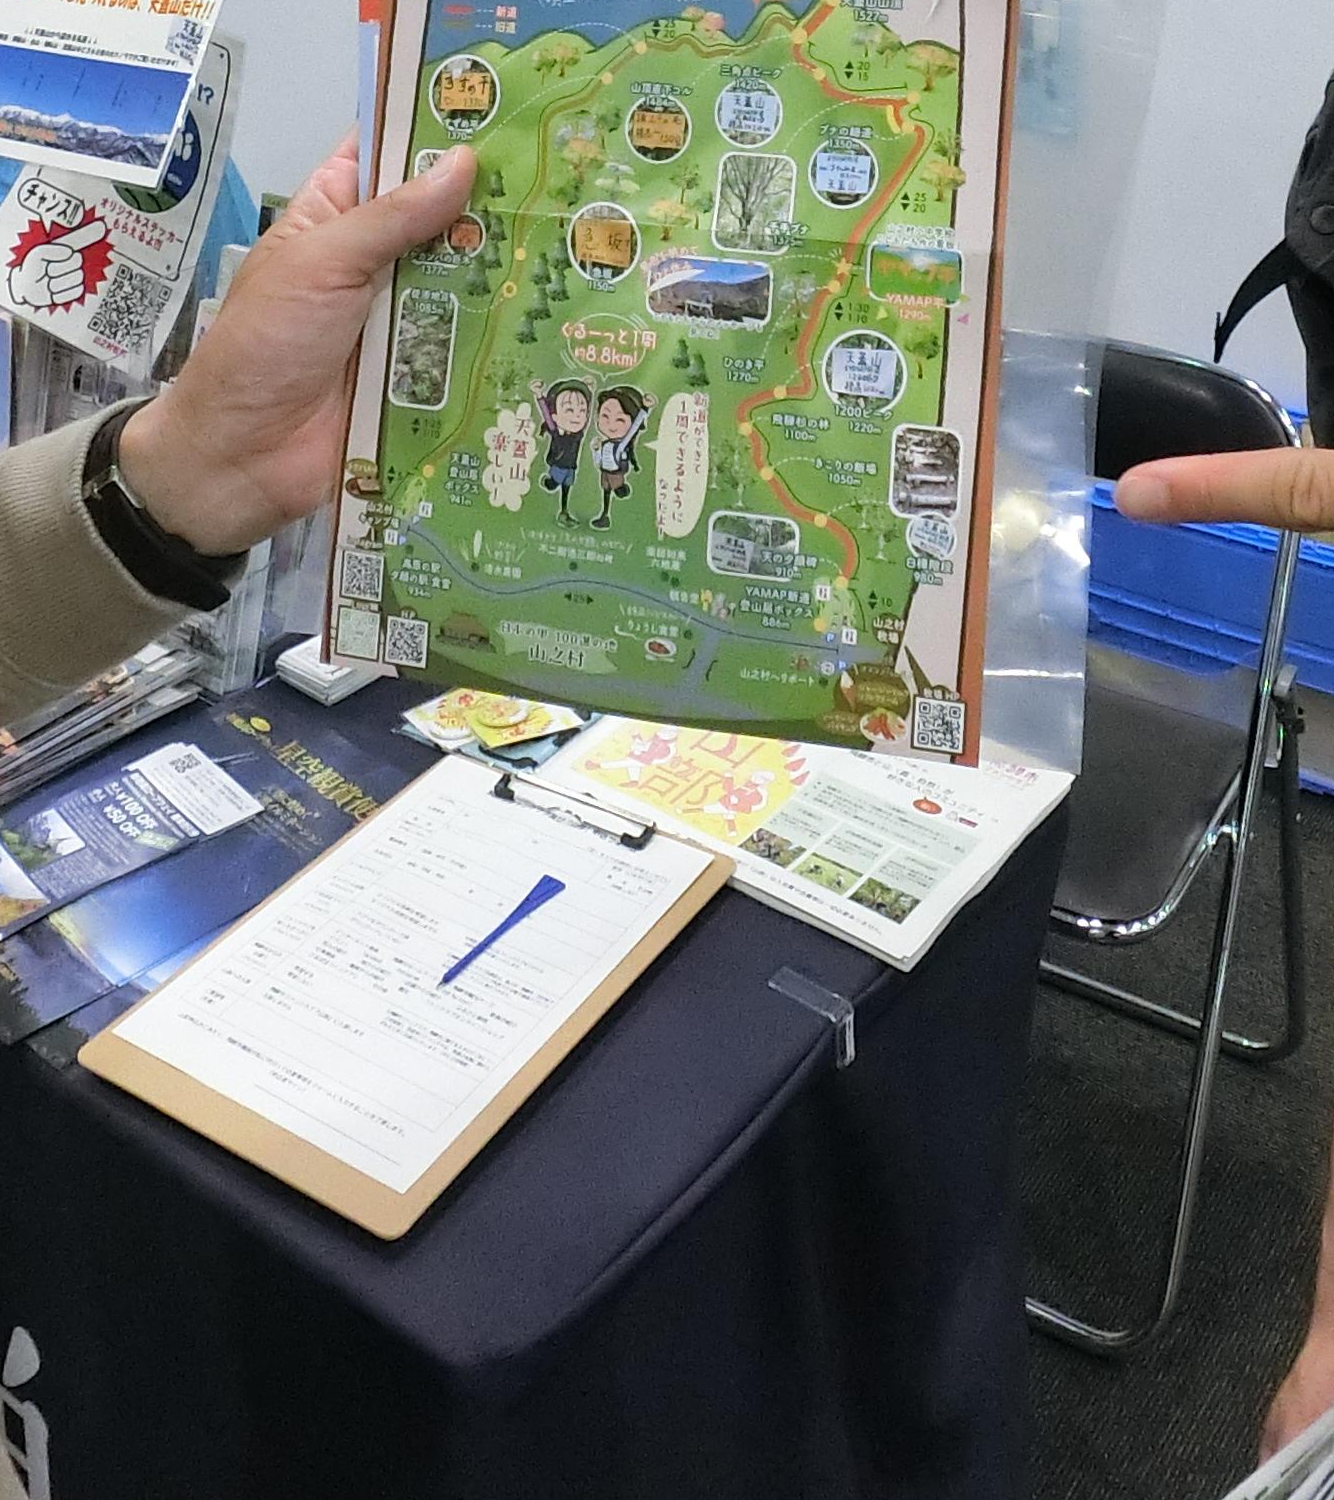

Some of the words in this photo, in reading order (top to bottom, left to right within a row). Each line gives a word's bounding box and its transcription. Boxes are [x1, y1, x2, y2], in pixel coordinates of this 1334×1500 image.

[23, 183, 80, 226] チャンス!!
[100, 197, 185, 245] オリジナルステッカー
[723, 355, 765, 371] ひのき平
[509, 418, 532, 482] 天蓋山
[528, 643, 586, 668] 山之村
